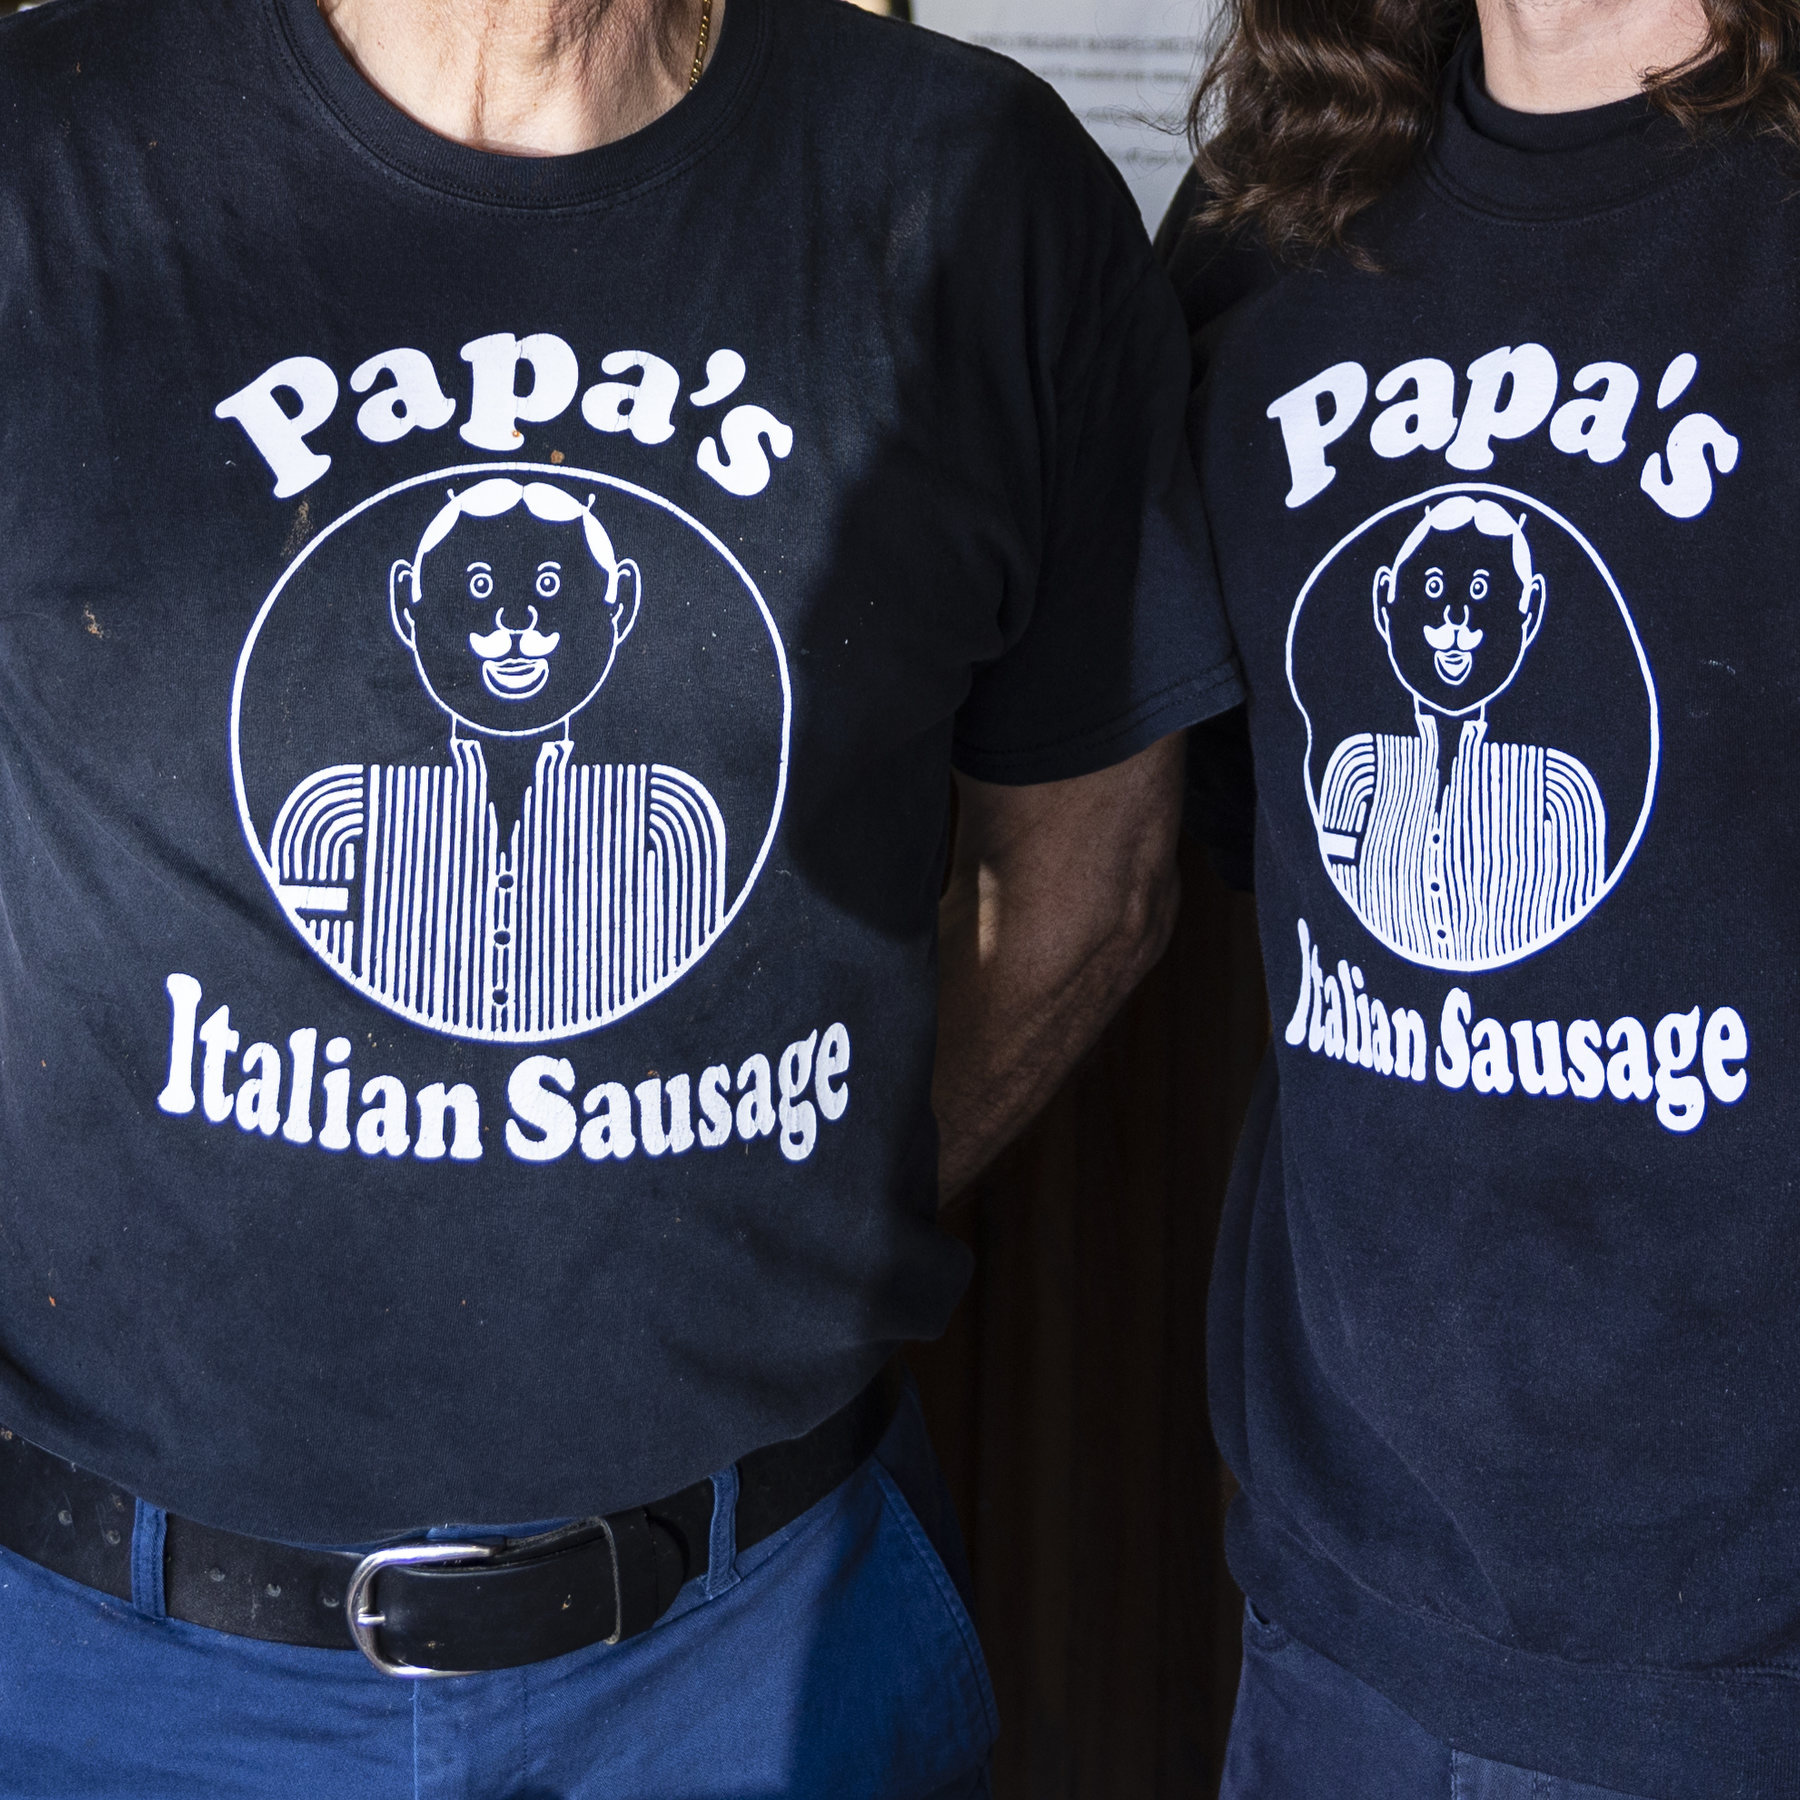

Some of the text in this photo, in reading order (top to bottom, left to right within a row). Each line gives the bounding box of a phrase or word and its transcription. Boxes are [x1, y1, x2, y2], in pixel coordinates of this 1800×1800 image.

[215, 332, 794, 500] Papa's
[1266, 342, 1740, 519] Papa's
[157, 972, 851, 1161] Italian Sausage
[1285, 917, 1749, 1132] Italian Sausage
